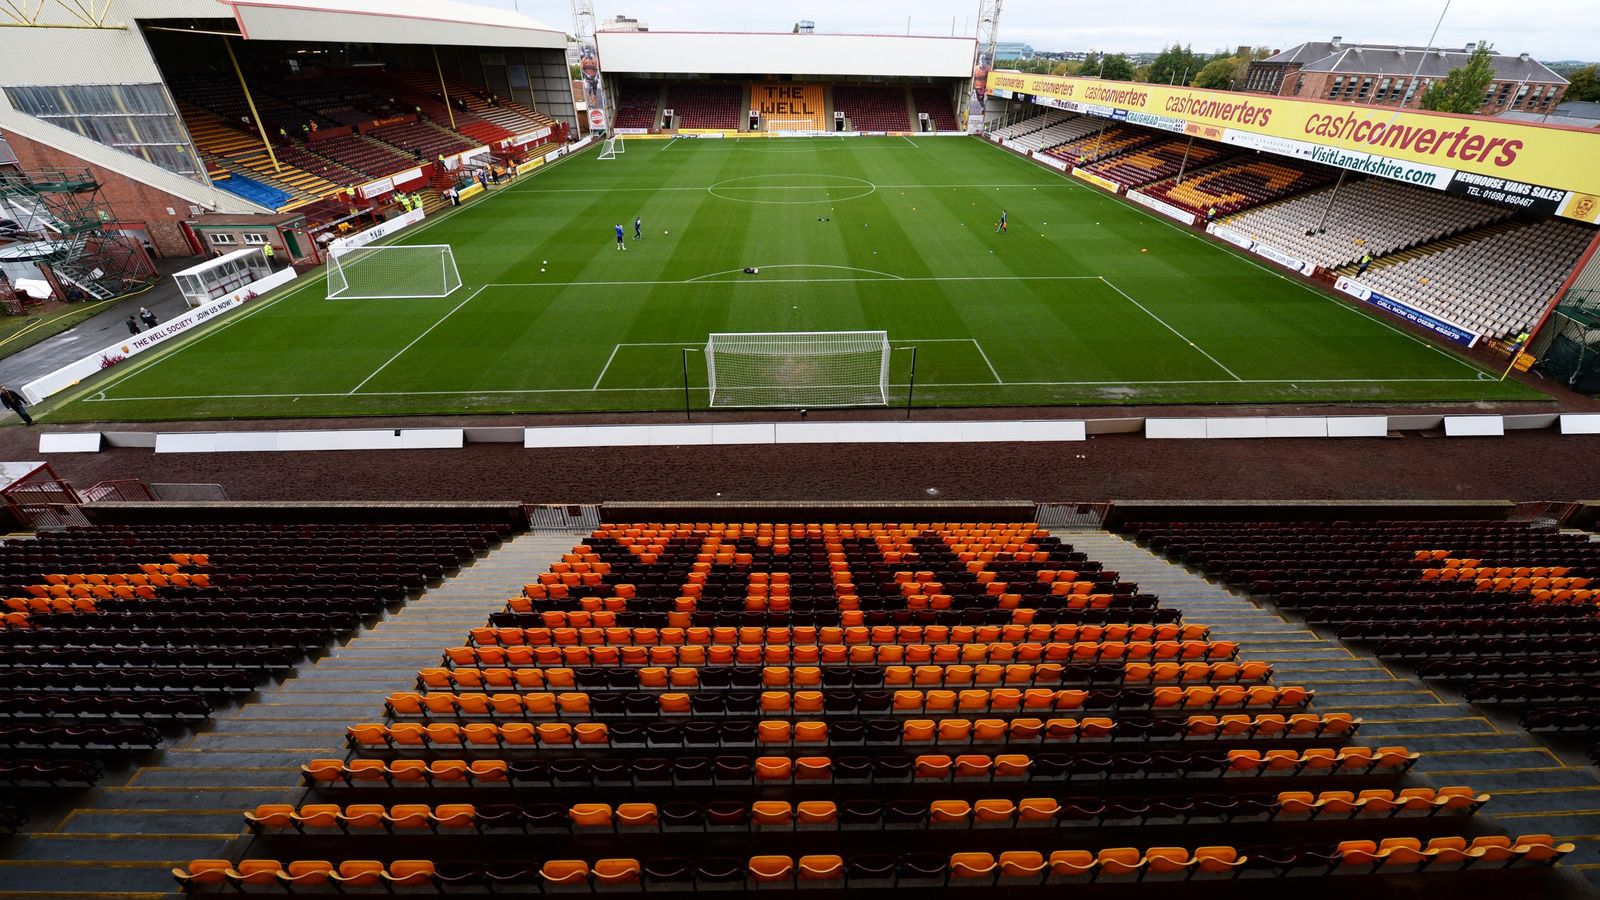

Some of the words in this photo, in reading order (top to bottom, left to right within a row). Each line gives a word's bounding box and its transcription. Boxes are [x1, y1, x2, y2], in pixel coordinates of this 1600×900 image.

[764, 86, 803, 98] THE
[1032, 78, 1074, 96] cashconverters
[1084, 84, 1148, 107] cashconverters
[761, 102, 815, 114] WELL
[1127, 112, 1158, 126] CRAIGHEAD
[1165, 93, 1272, 127] cashconverters
[1304, 110, 1524, 167] cashconverters
[1310, 146, 1437, 186] VisitLanarkshire.com
[1454, 171, 1505, 190] NEWHOUSE
[1503, 181, 1532, 195] VANS
[1531, 186, 1564, 202] SALES
[1467, 186, 1484, 196] TEL:
[1482, 189, 1506, 201] 01698
[1504, 195, 1534, 207] 860467
[1377, 300, 1391, 310] CALL
[1392, 307, 1407, 316] NOW
[1407, 313, 1417, 321] ON
[133, 338, 149, 349] THE
[148, 330, 167, 342] WELL
[167, 317, 193, 334] SOCIETY
[196, 311, 210, 320] JOIN
[209, 306, 218, 314] US
[217, 299, 234, 310] NOW!
